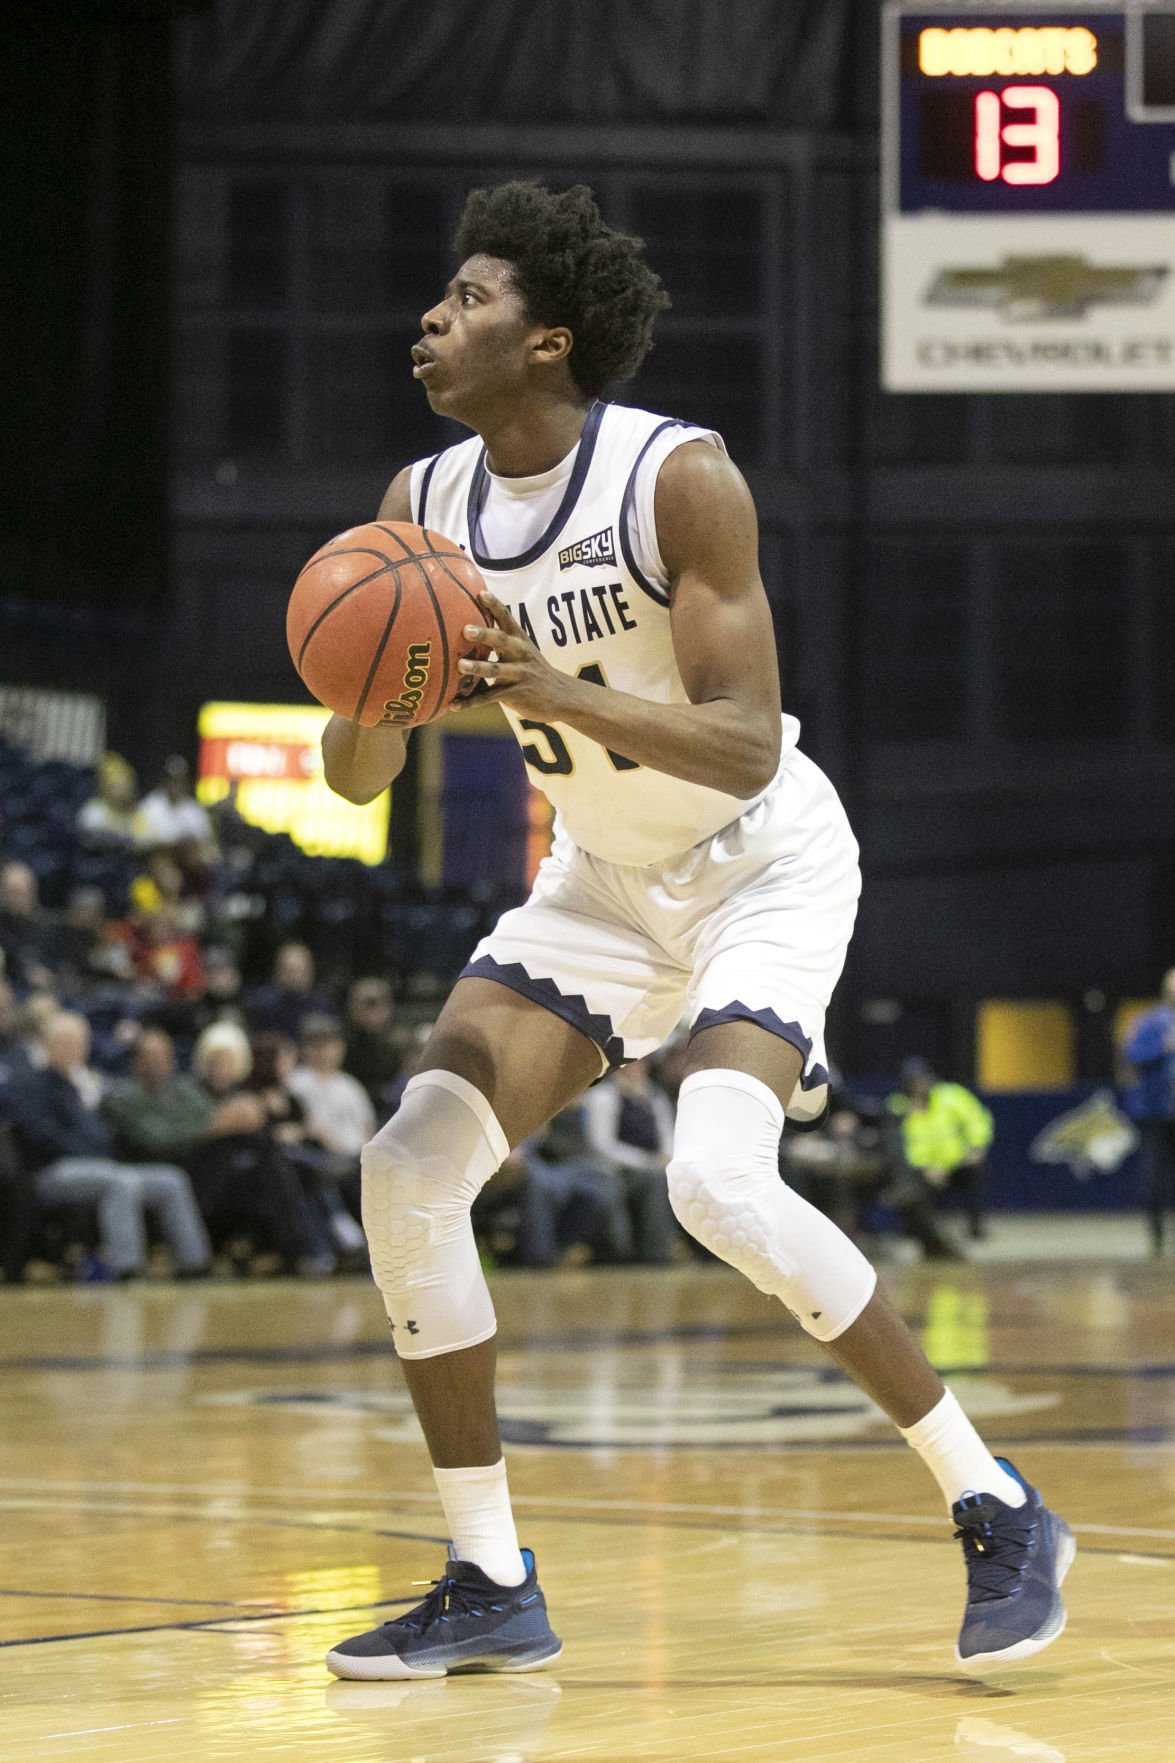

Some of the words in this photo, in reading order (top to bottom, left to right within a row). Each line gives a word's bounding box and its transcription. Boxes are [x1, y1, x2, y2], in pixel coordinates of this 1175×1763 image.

[974, 85, 1060, 185] 13
[547, 583, 638, 647] STATE
[378, 640, 432, 727] ilson
